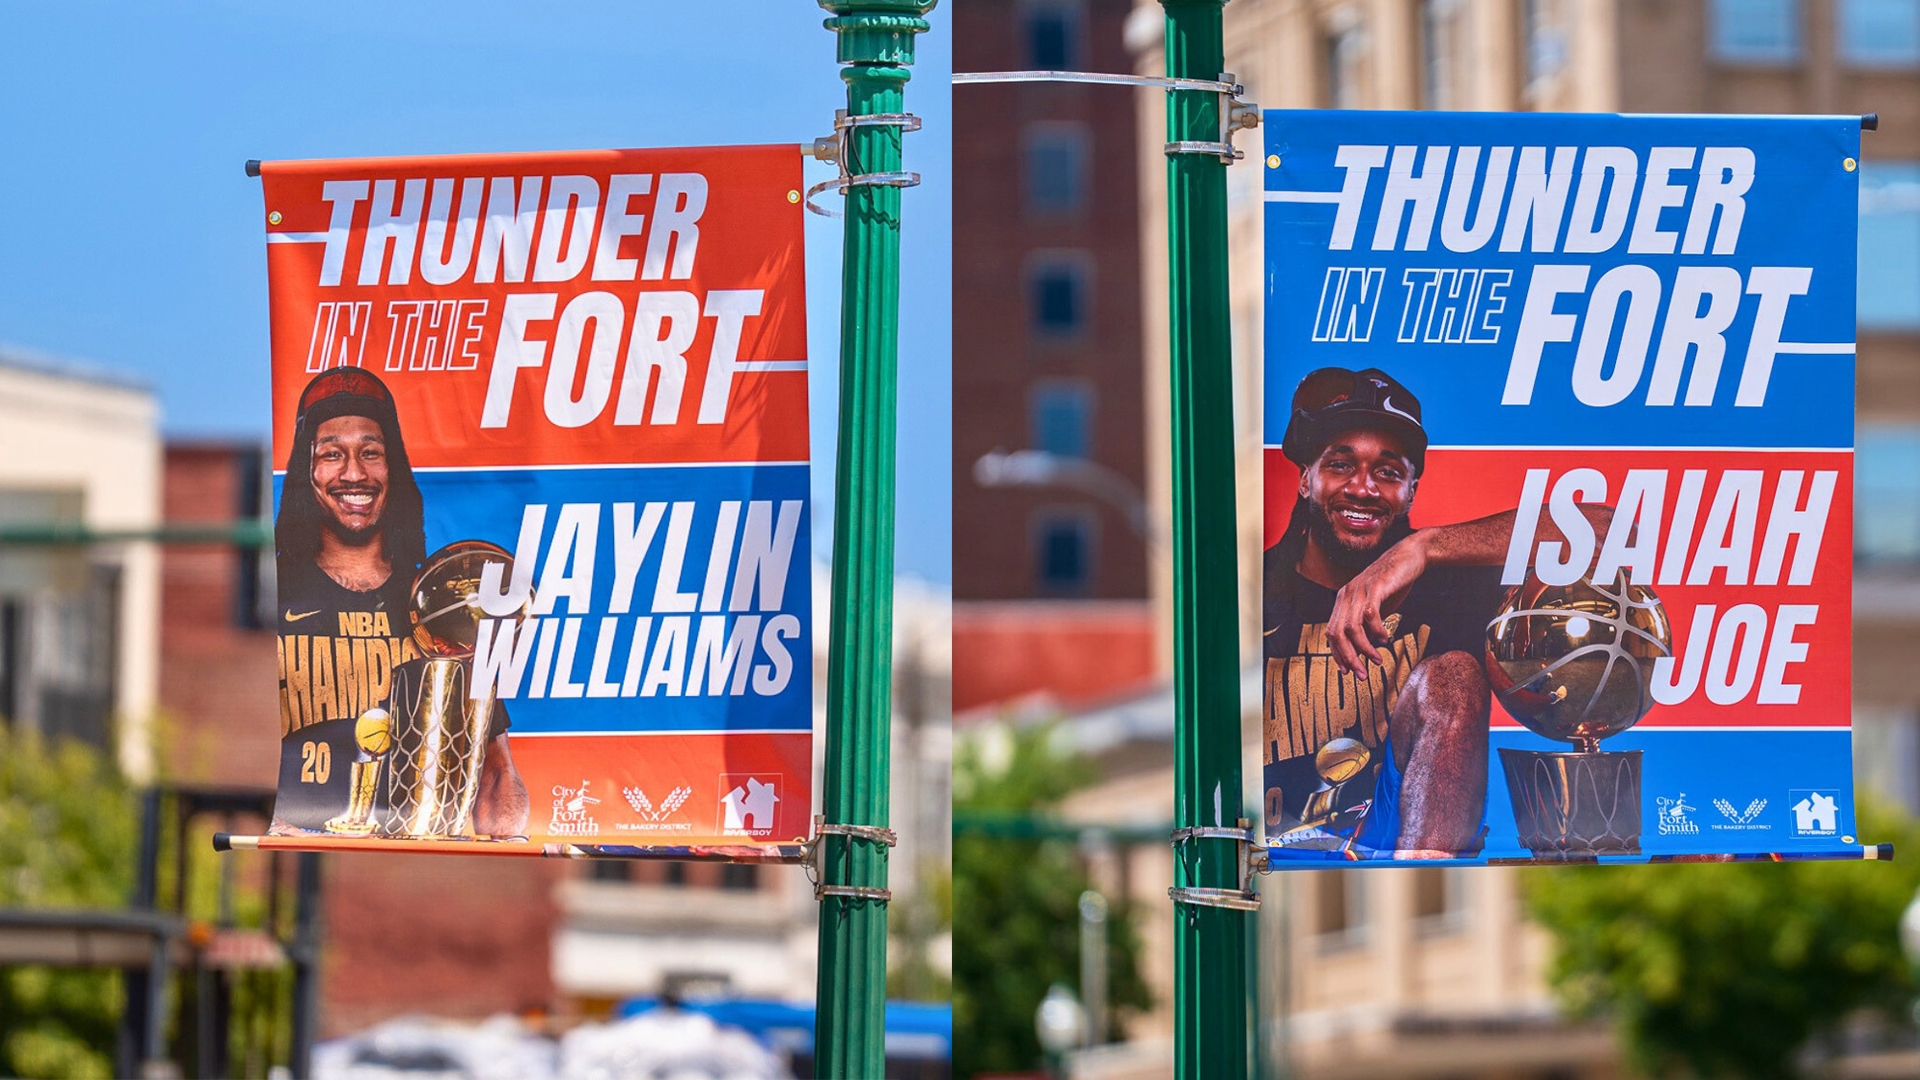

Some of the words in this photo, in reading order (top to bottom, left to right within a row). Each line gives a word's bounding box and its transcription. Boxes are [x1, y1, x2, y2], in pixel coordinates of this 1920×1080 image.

[1328, 144, 1756, 255] THUNDER
[318, 172, 709, 287] THUNDER
[1311, 266, 1386, 342] IN
[1396, 267, 1513, 344] THE
[1500, 263, 1814, 407] FORT
[306, 301, 372, 373] IN
[384, 299, 489, 372] THE
[480, 289, 765, 428] FORT
[1500, 467, 1840, 586] ISAIAH
[479, 500, 803, 617] JAYLIN
[338, 611, 392, 637] NBA
[469, 614, 801, 700] WILLIAMS
[1649, 603, 1819, 706] JOE
[301, 741, 331, 785] 20
[551, 785, 576, 799] City
[552, 796, 565, 807] of
[1656, 796, 1676, 807] City
[1657, 805, 1668, 814] of
[547, 816, 600, 836] Smith
[551, 806, 587, 822] Fort
[1658, 812, 1688, 824] Fort
[1658, 820, 1700, 836] Smith
